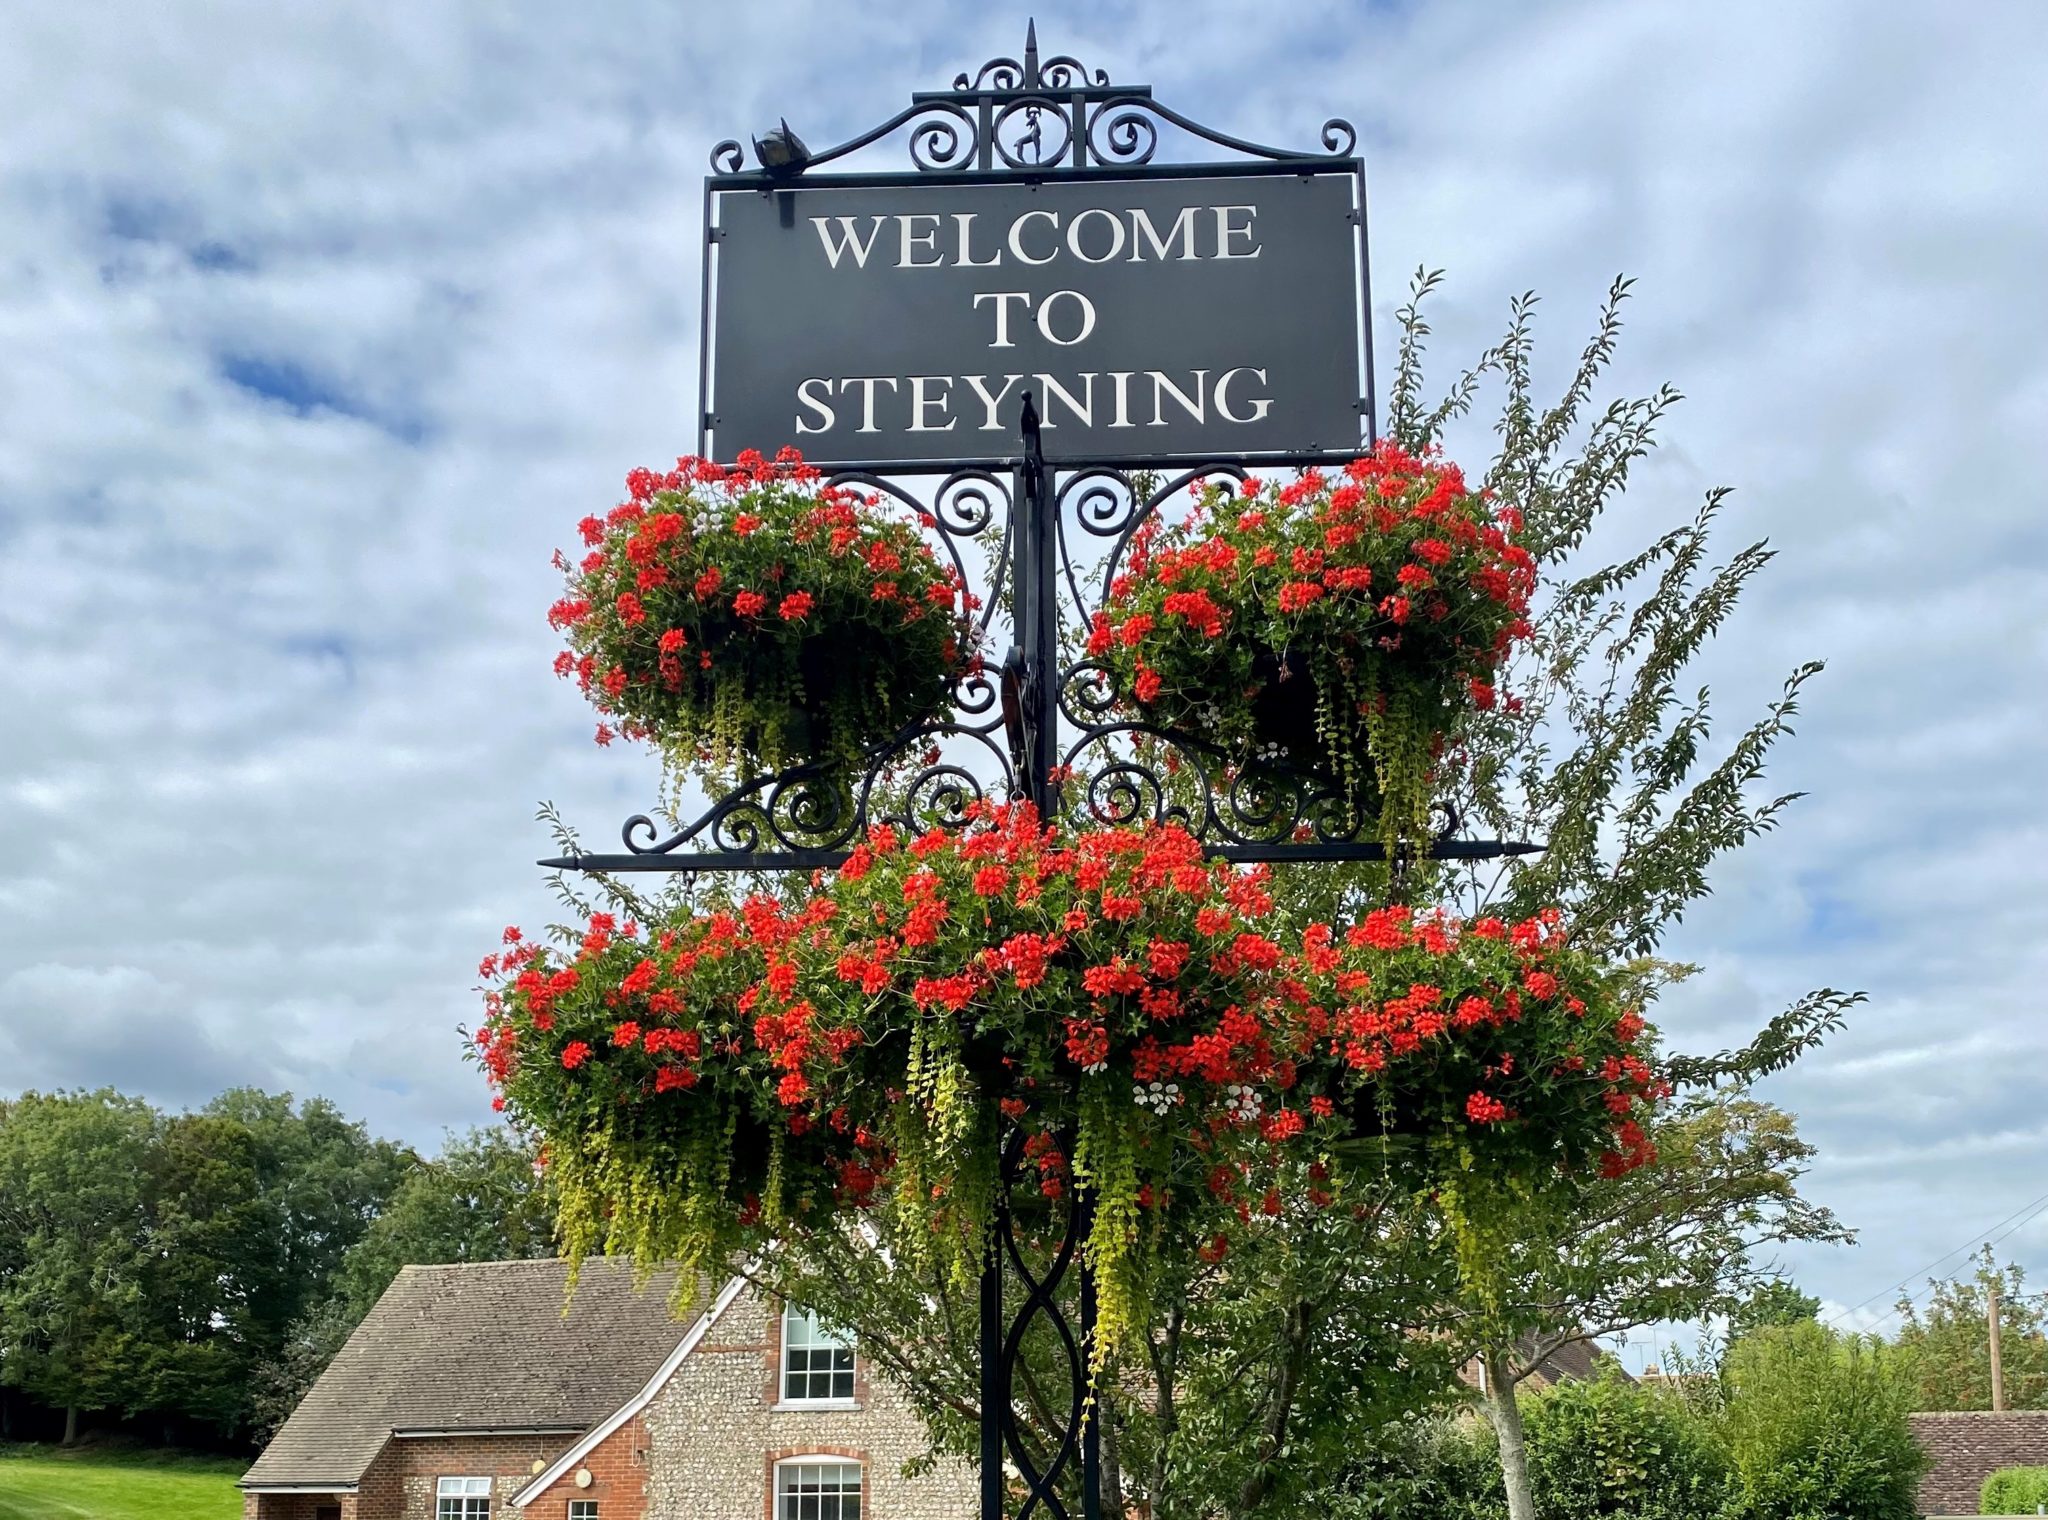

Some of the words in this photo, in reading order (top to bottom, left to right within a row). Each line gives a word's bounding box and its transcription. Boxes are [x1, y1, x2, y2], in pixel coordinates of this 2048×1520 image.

[809, 206, 1262, 269] WELCOME
[974, 291, 1096, 348] TO
[796, 368, 1275, 433] STEYNING
